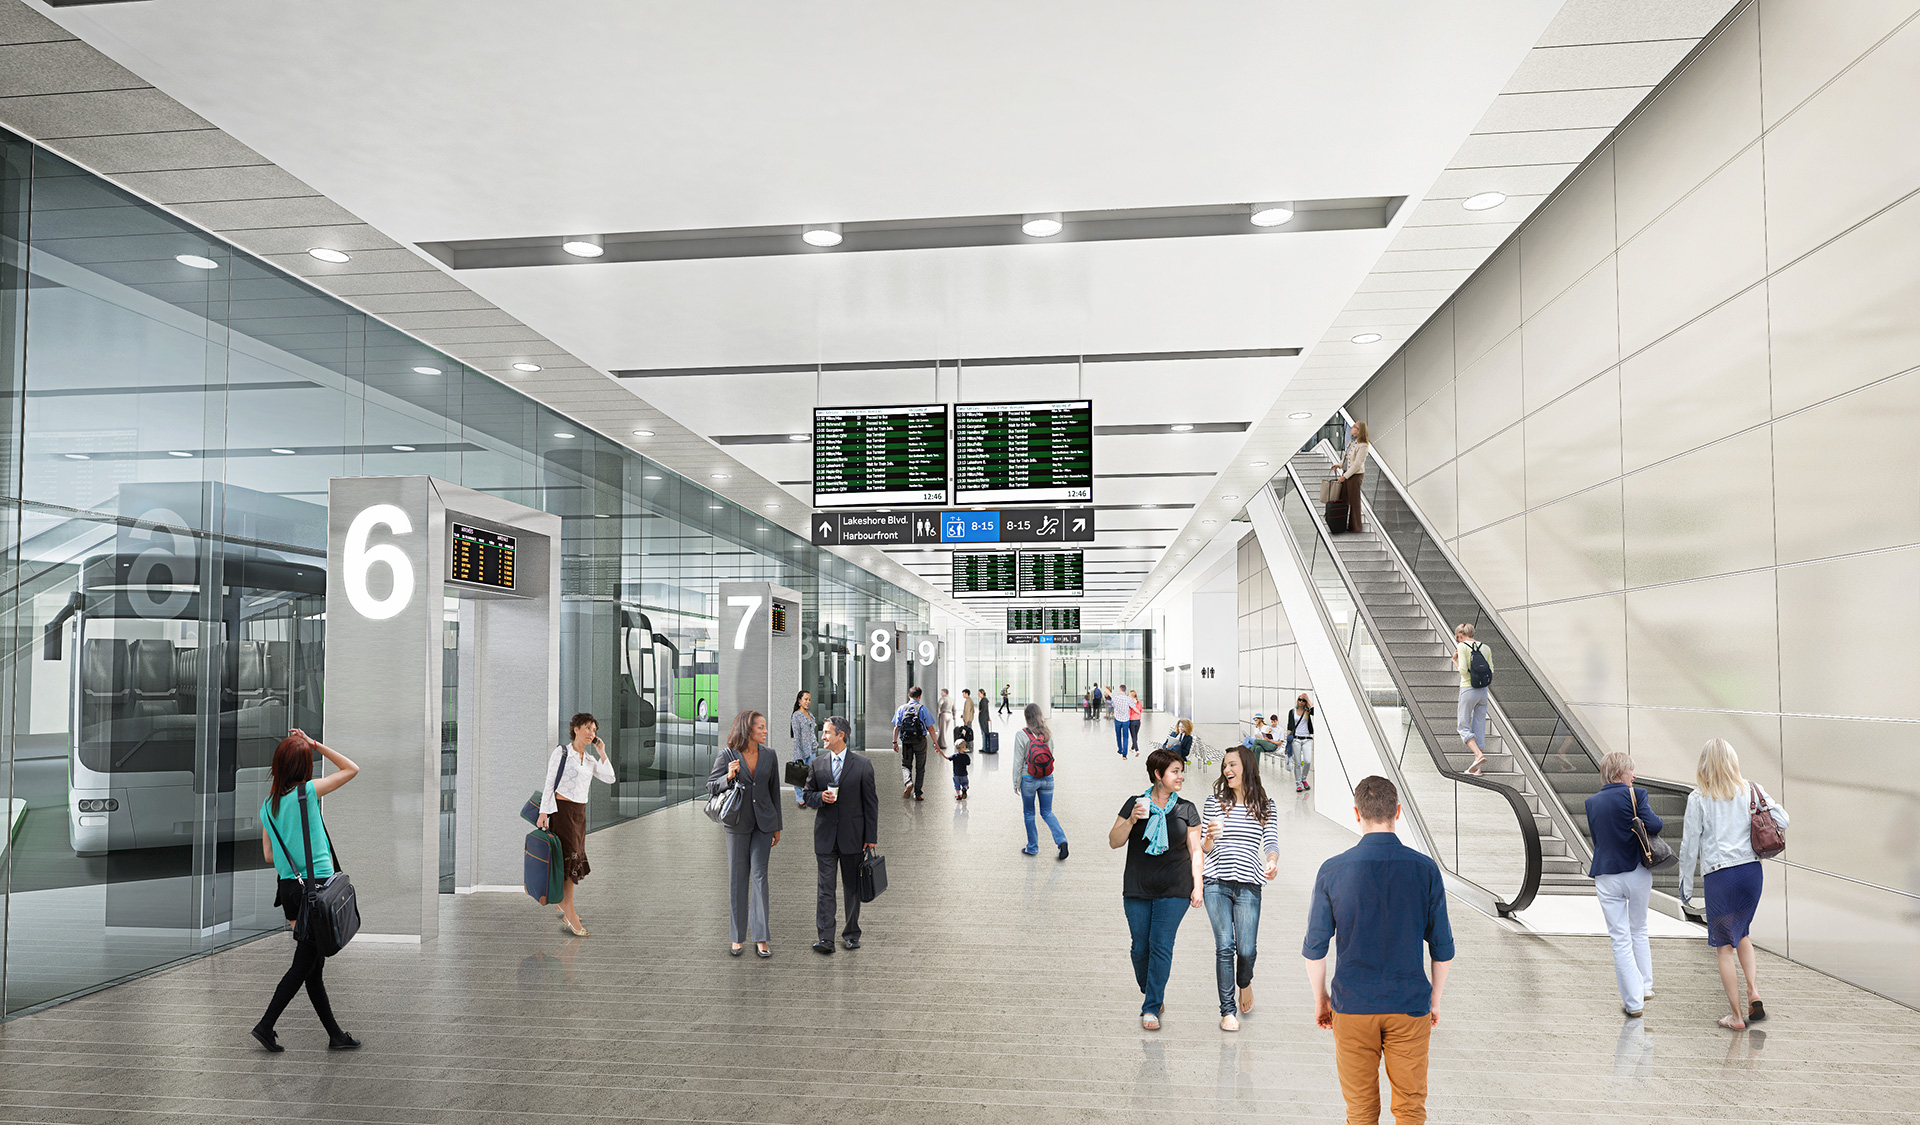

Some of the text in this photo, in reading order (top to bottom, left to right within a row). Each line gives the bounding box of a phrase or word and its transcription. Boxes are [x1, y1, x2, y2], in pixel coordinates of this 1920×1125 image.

[843, 515, 908, 525] Lakeshore Blvd.
[971, 521, 994, 531] 8-15
[1006, 521, 1031, 531] 8-15
[843, 531, 898, 540] Harbourfront
[343, 505, 415, 620] 6
[727, 596, 762, 650] 7
[869, 629, 892, 662] 8
[918, 641, 936, 666] 9
